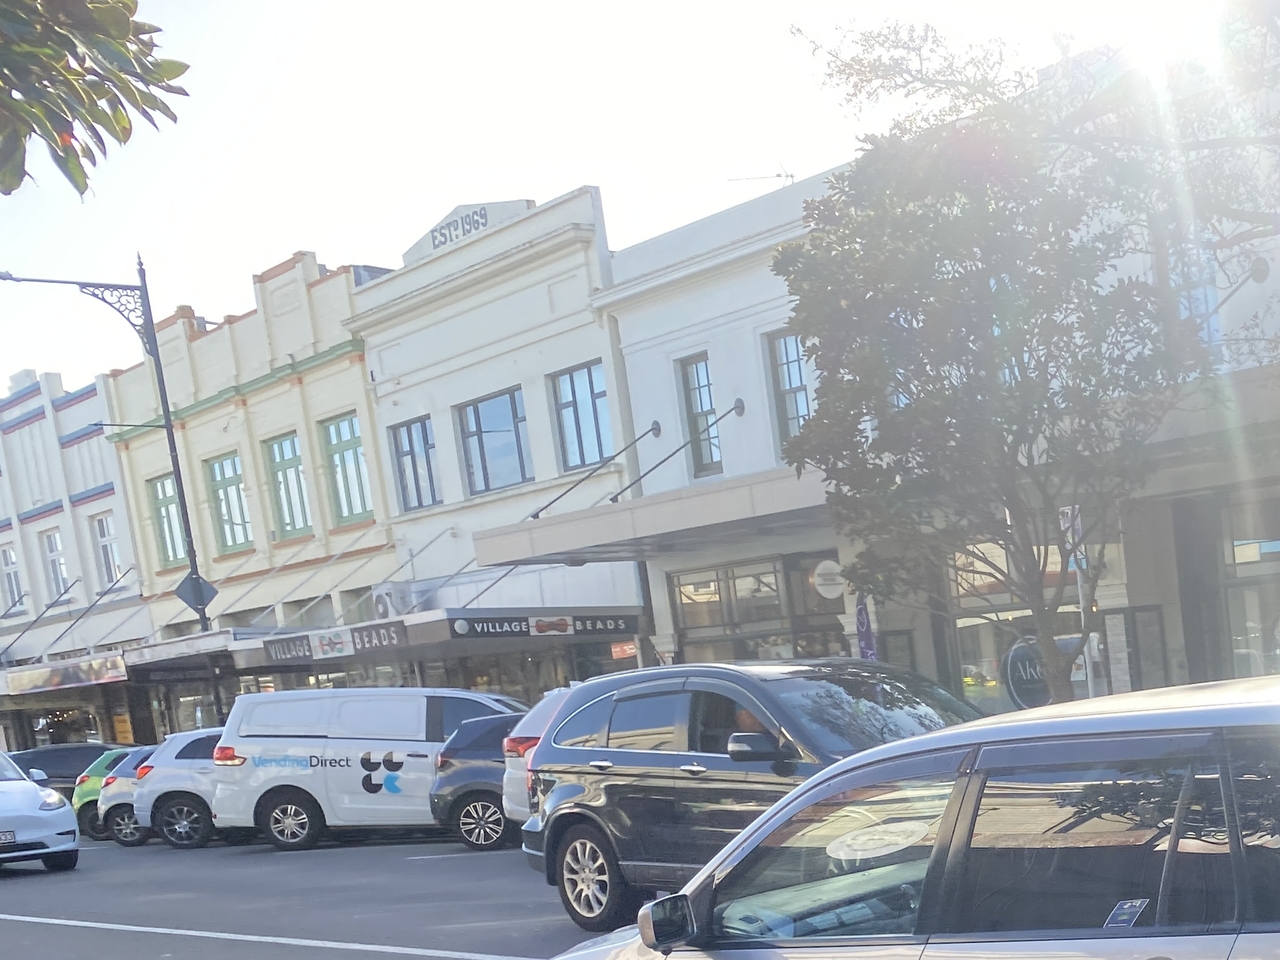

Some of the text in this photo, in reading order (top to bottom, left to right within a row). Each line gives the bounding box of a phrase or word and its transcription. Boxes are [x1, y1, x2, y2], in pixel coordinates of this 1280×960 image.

[460, 206, 488, 237] 1969
[474, 619, 626, 633] VILLAGE BEADS
[270, 626, 399, 661] VILLAGE BEADS
[252, 755, 352, 770] VendingDirect
